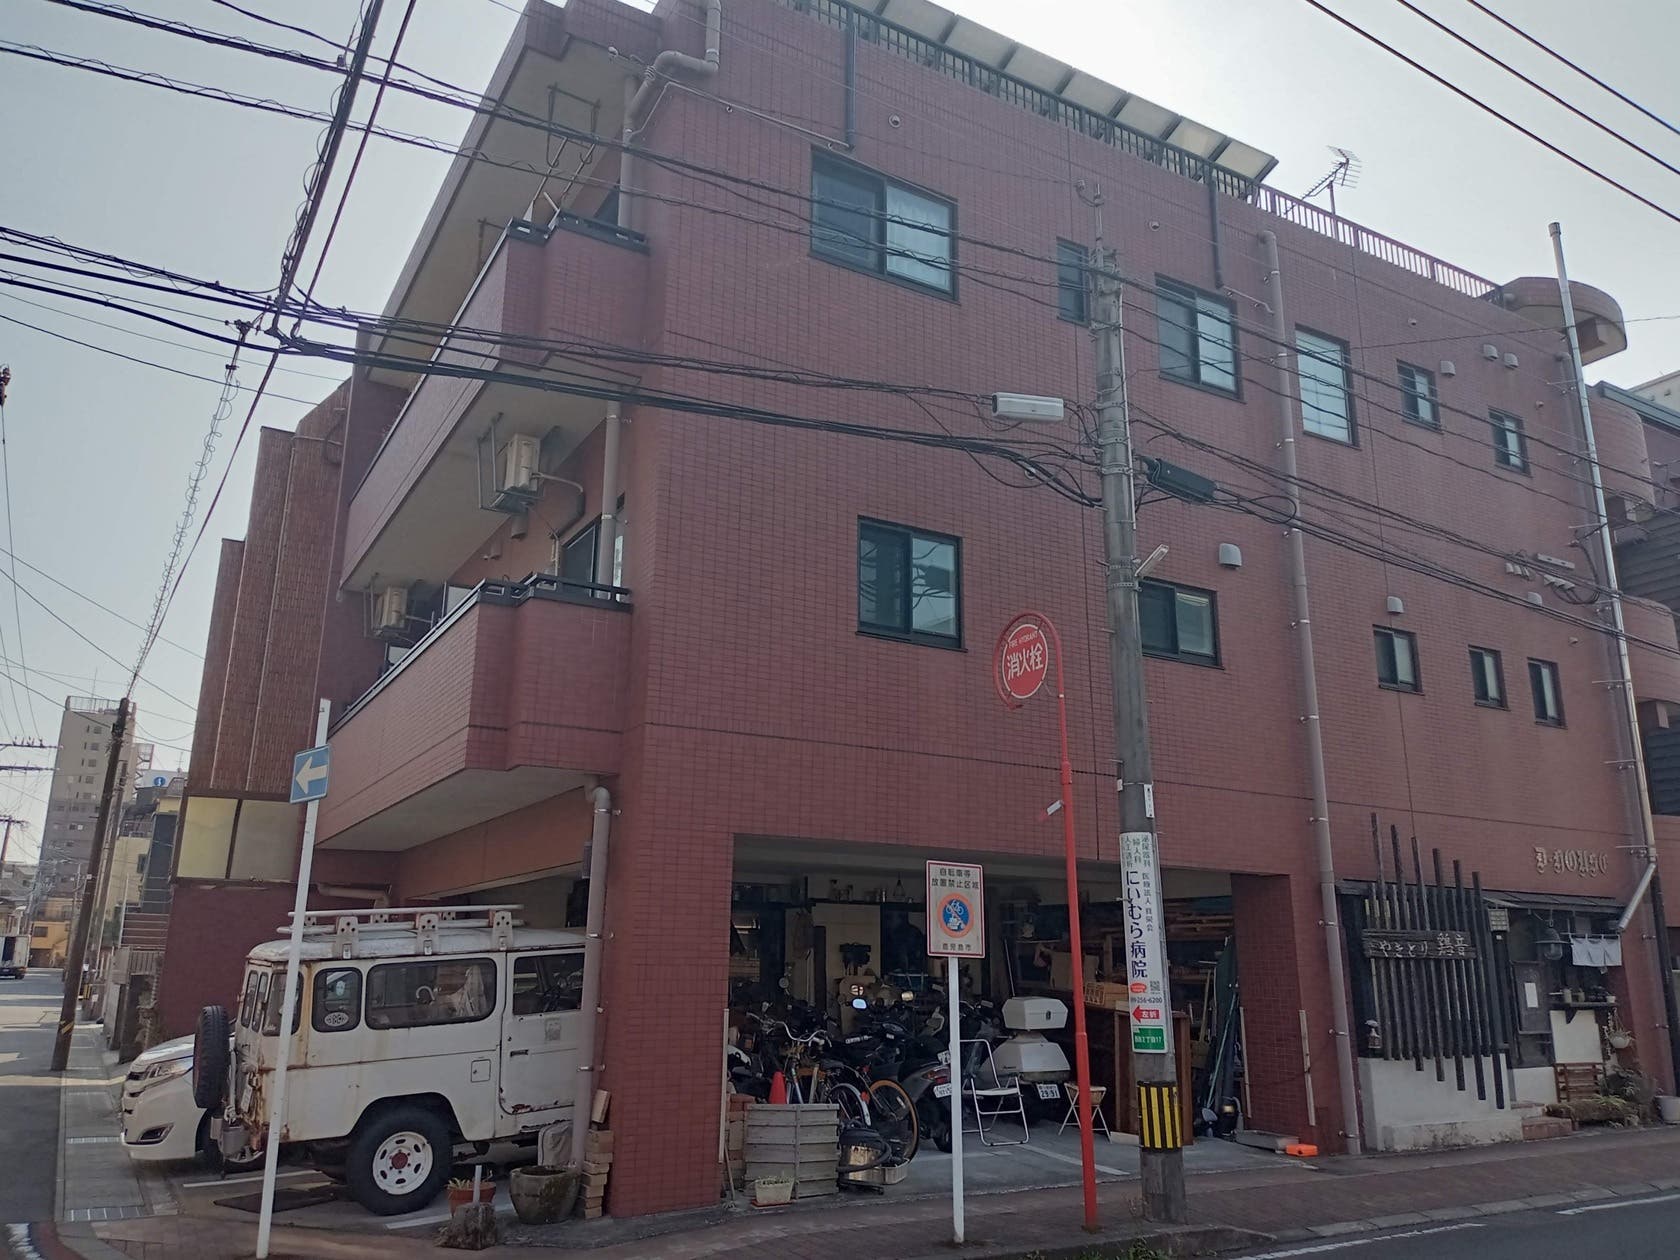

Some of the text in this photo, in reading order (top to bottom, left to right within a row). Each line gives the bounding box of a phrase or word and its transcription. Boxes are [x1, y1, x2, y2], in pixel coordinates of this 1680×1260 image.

[1007, 642, 1044, 680] 消火栓
[940, 867, 971, 877] 自転車等
[931, 878, 980, 889] 放置禁止区域
[1126, 870, 1148, 978] にいむら病院
[1379, 940, 1428, 958] やきとり
